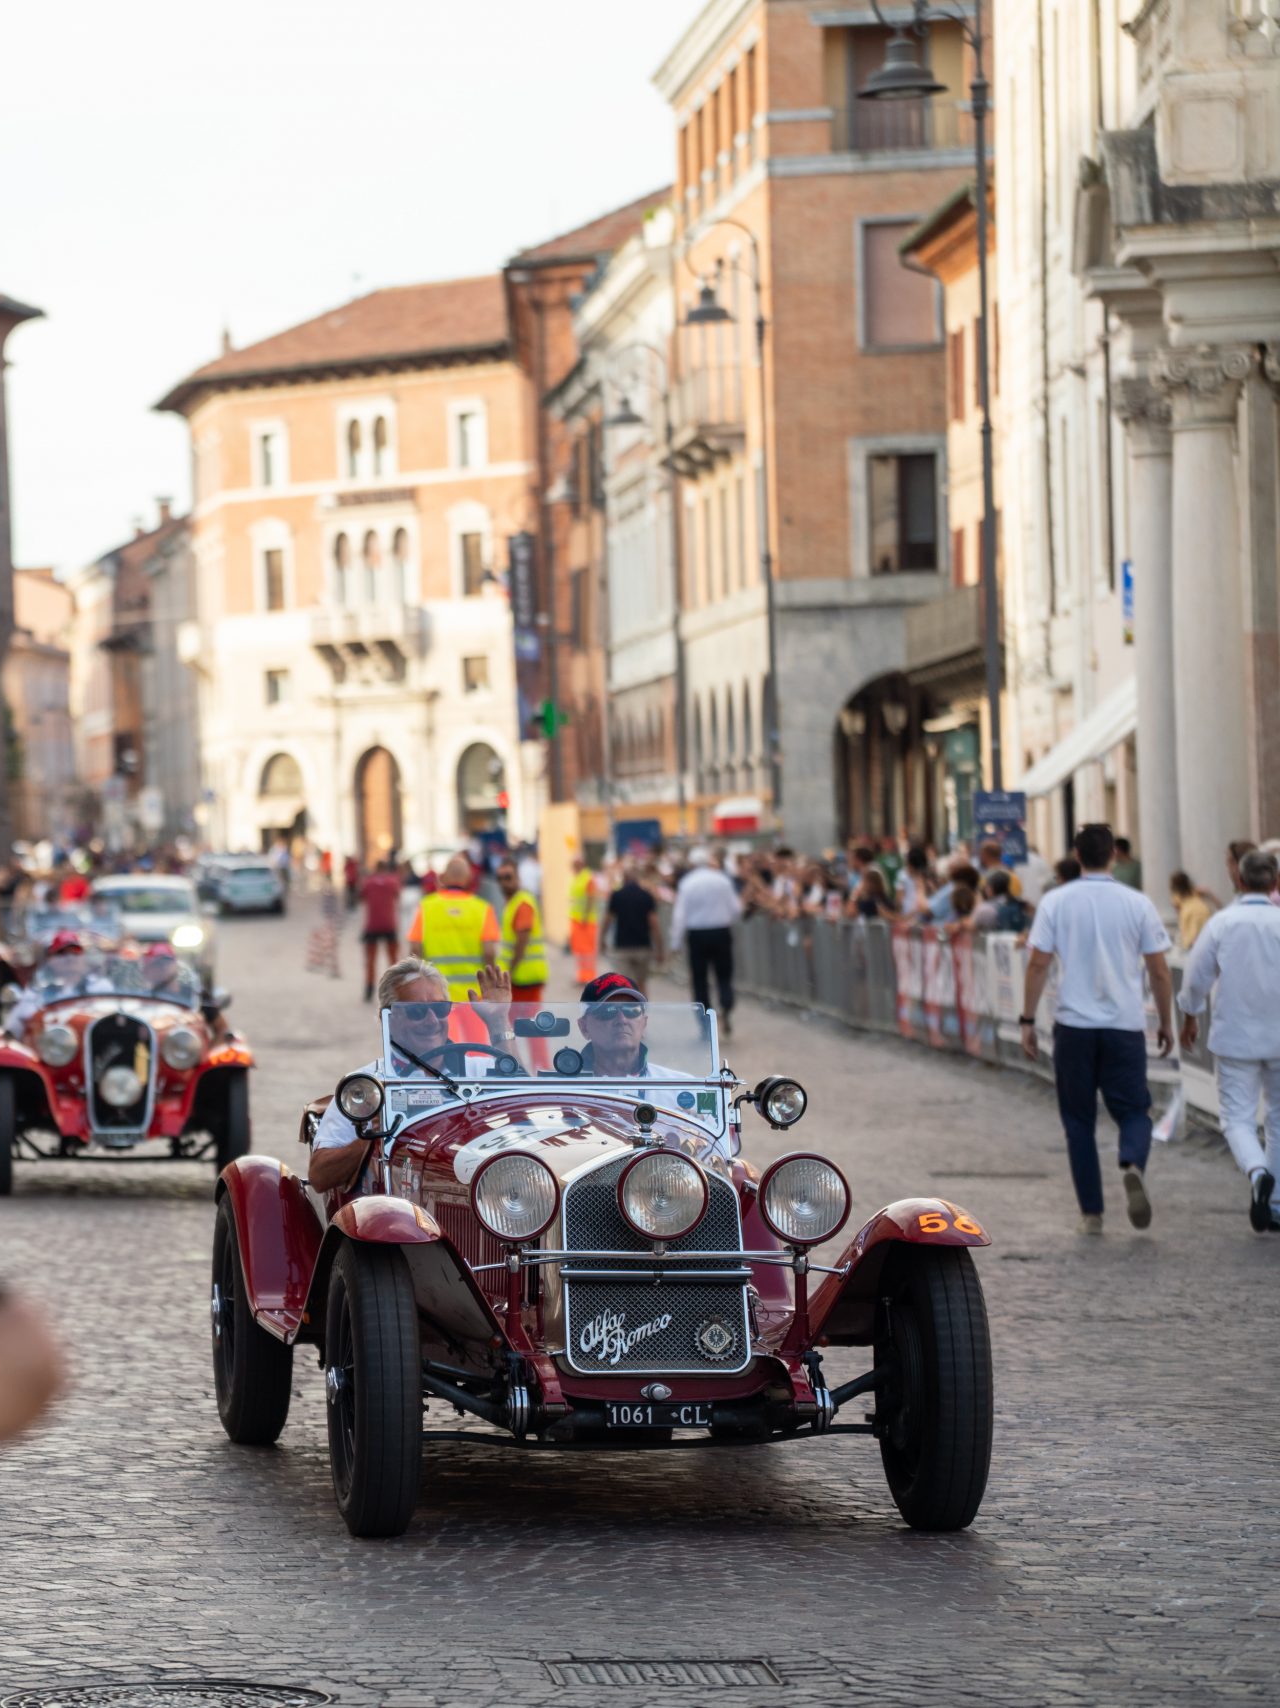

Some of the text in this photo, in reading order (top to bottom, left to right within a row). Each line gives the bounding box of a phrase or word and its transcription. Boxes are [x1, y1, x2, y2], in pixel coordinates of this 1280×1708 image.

[918, 1212, 982, 1236] 56
[580, 1308, 620, 1360] Alfa
[606, 1313, 673, 1365] Romeo
[611, 1406, 708, 1424] 1061 CL
